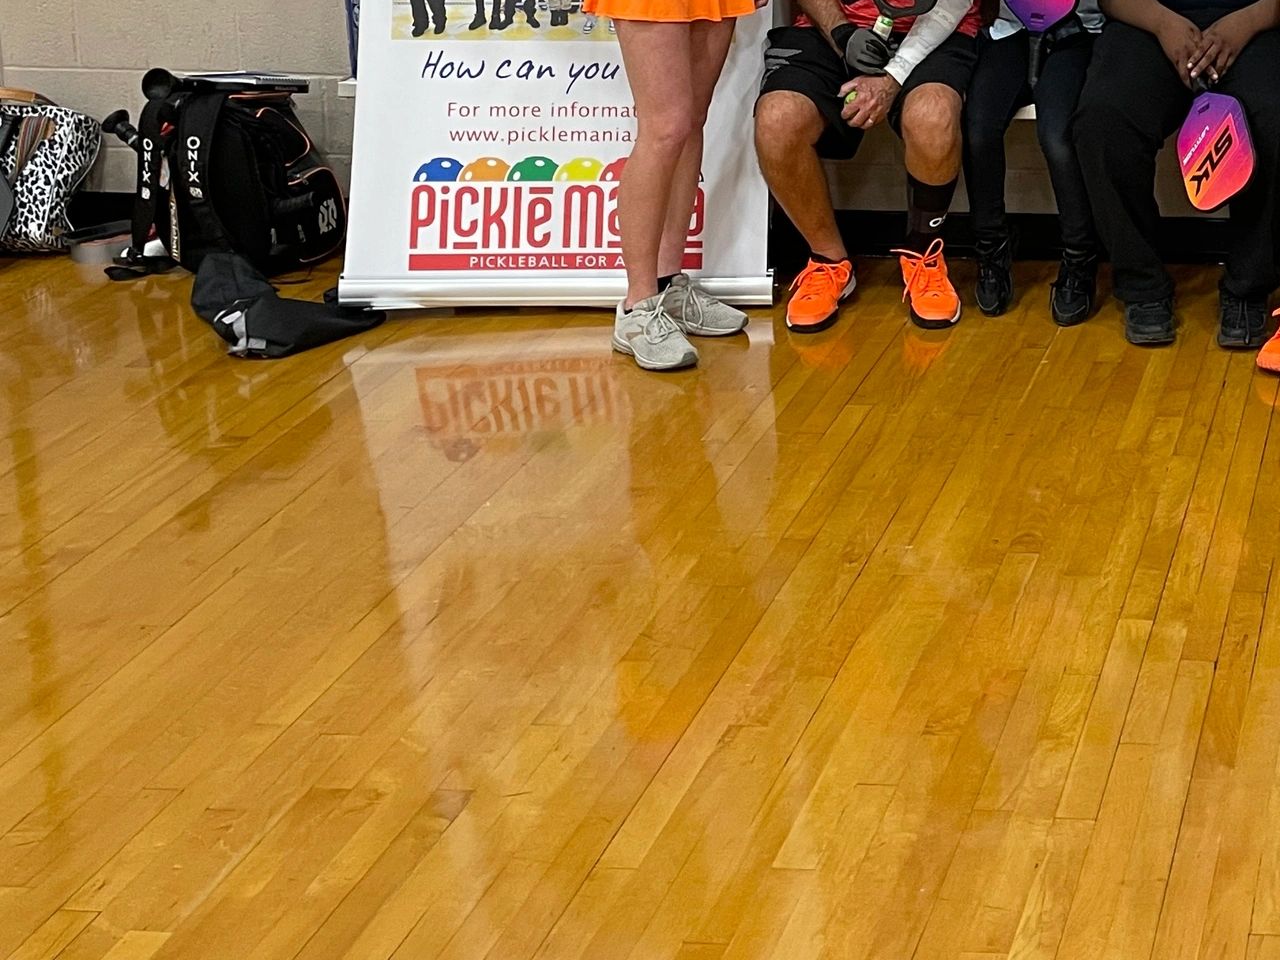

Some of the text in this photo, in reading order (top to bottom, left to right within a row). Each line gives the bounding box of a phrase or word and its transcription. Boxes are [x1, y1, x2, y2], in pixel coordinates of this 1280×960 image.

[421, 50, 621, 95] How can you
[447, 101, 637, 118] For more informat
[449, 125, 637, 145] www.picklemania.
[142, 137, 153, 184] ONIX
[186, 136, 201, 183] ONIX
[1189, 124, 1234, 198] SLK
[469, 255, 569, 268] PICKLEBALL
[575, 255, 608, 268] FOR
